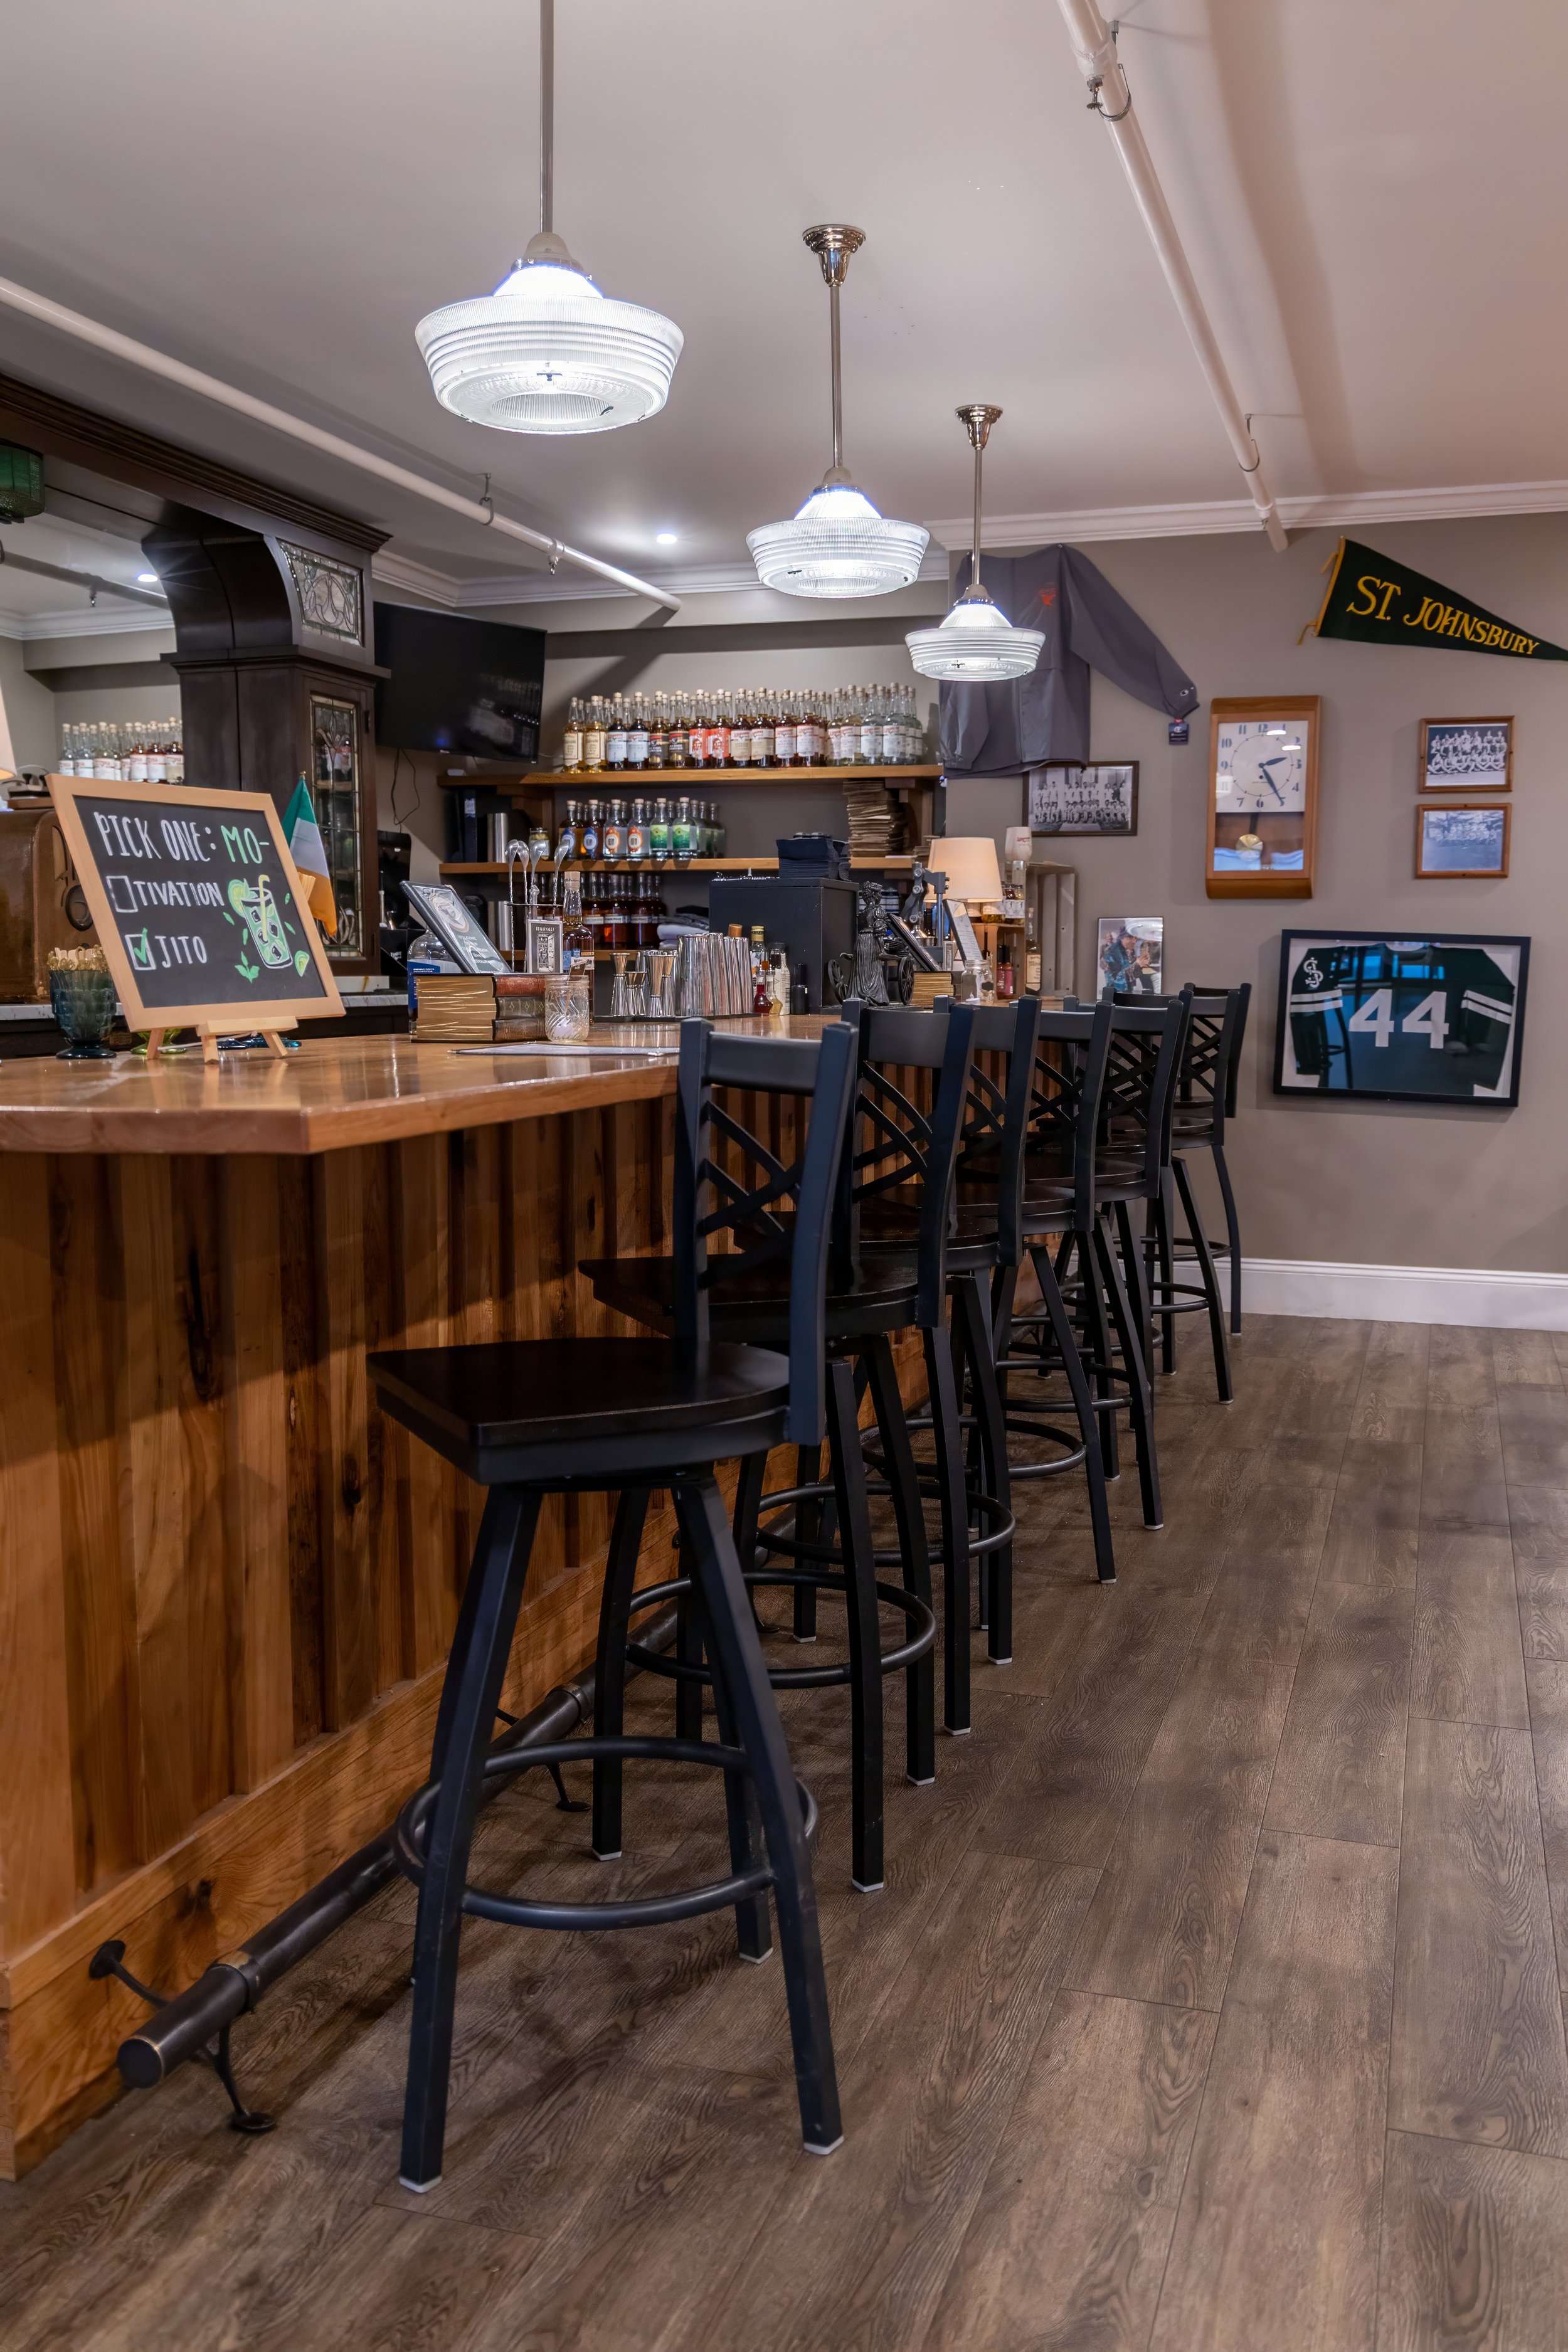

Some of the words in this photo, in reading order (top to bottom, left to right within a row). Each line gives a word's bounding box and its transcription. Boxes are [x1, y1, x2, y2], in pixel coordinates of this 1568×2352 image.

[1346, 575, 1401, 620] ST.
[1402, 596, 1540, 655] JOHNSBURY
[1239, 724, 1247, 734] 11
[1221, 738, 1232, 748] 10
[1221, 761, 1228, 770] 9
[1291, 782, 1300, 792] 4
[1236, 797, 1245, 807] 7
[1256, 799, 1264, 808] 6
[93, 811, 162, 859] PICK
[160, 819, 217, 862] ONE:
[220, 825, 270, 864] MO-
[132, 880, 225, 908] TIVATION
[154, 935, 208, 968] JITO
[1348, 988, 1449, 1049] 44
